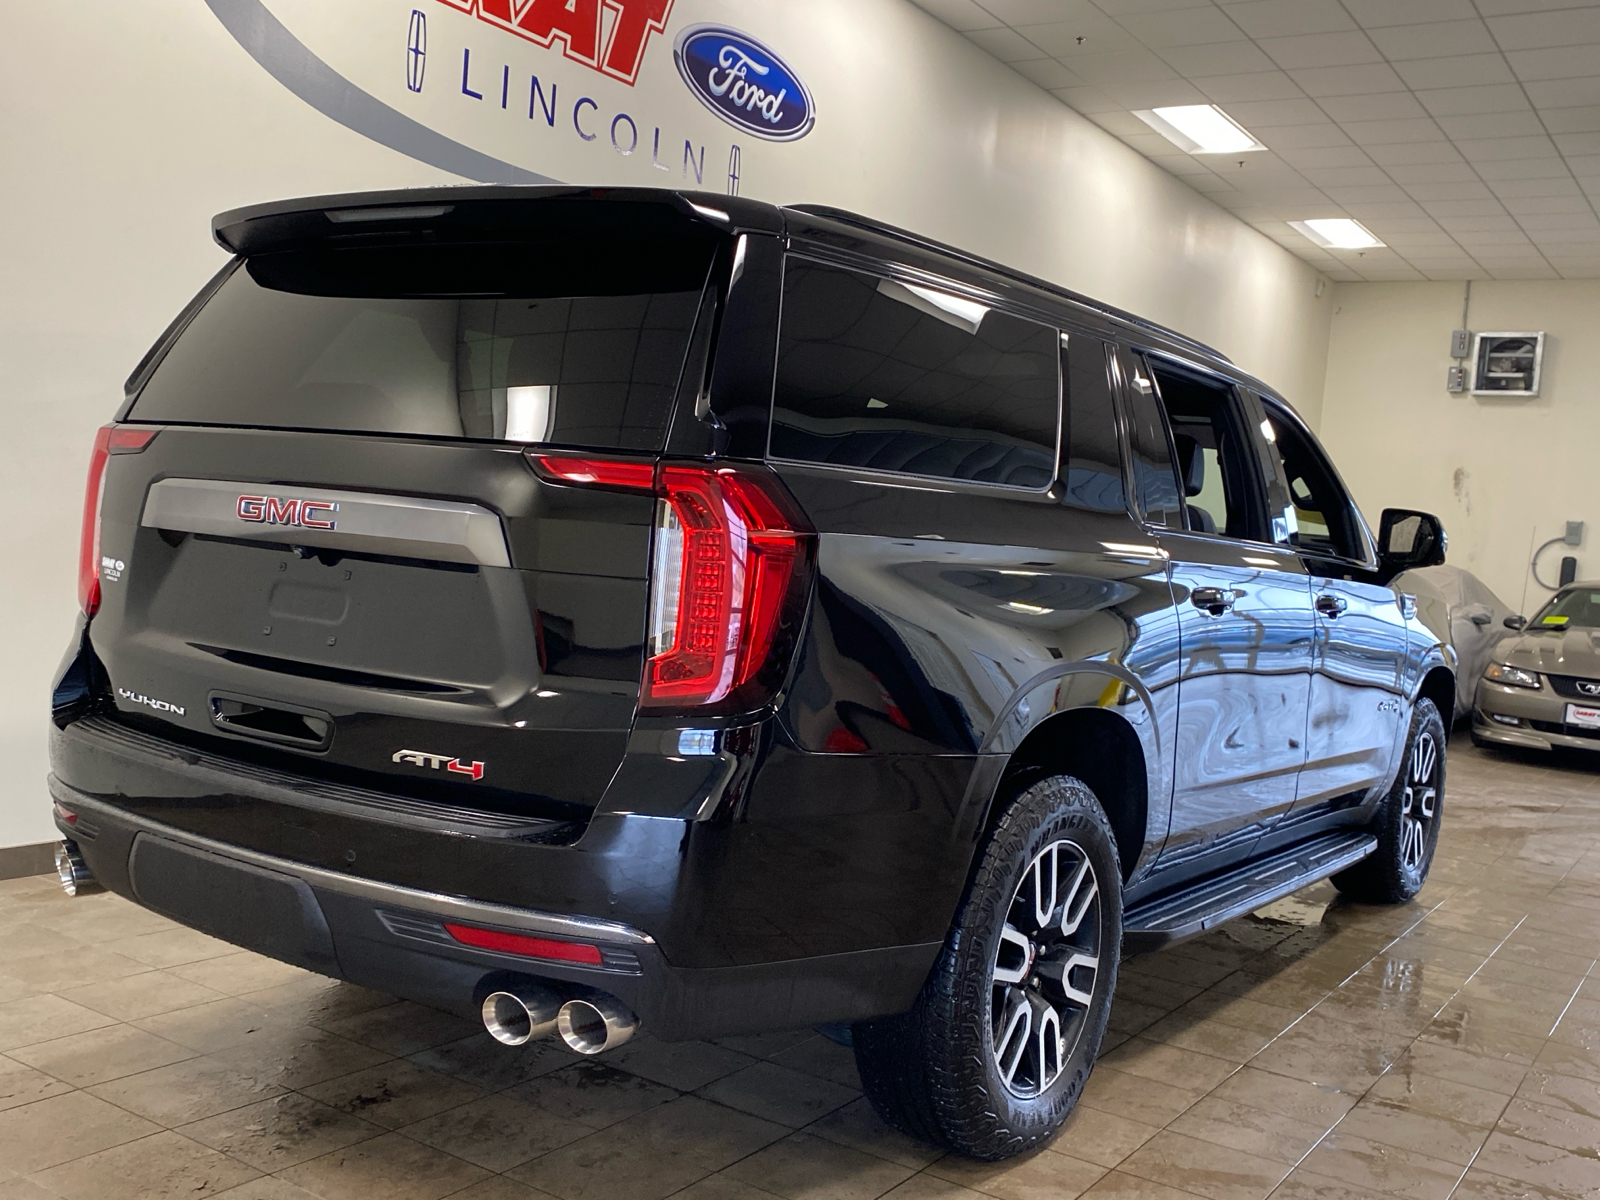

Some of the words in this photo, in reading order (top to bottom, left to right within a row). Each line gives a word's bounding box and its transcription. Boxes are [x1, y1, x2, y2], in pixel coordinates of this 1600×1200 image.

[708, 45, 788, 123] Ford
[461, 48, 706, 185] LINCOLN
[236, 494, 340, 531] GMC
[118, 687, 186, 716] YUKON
[392, 749, 485, 781] AT4
